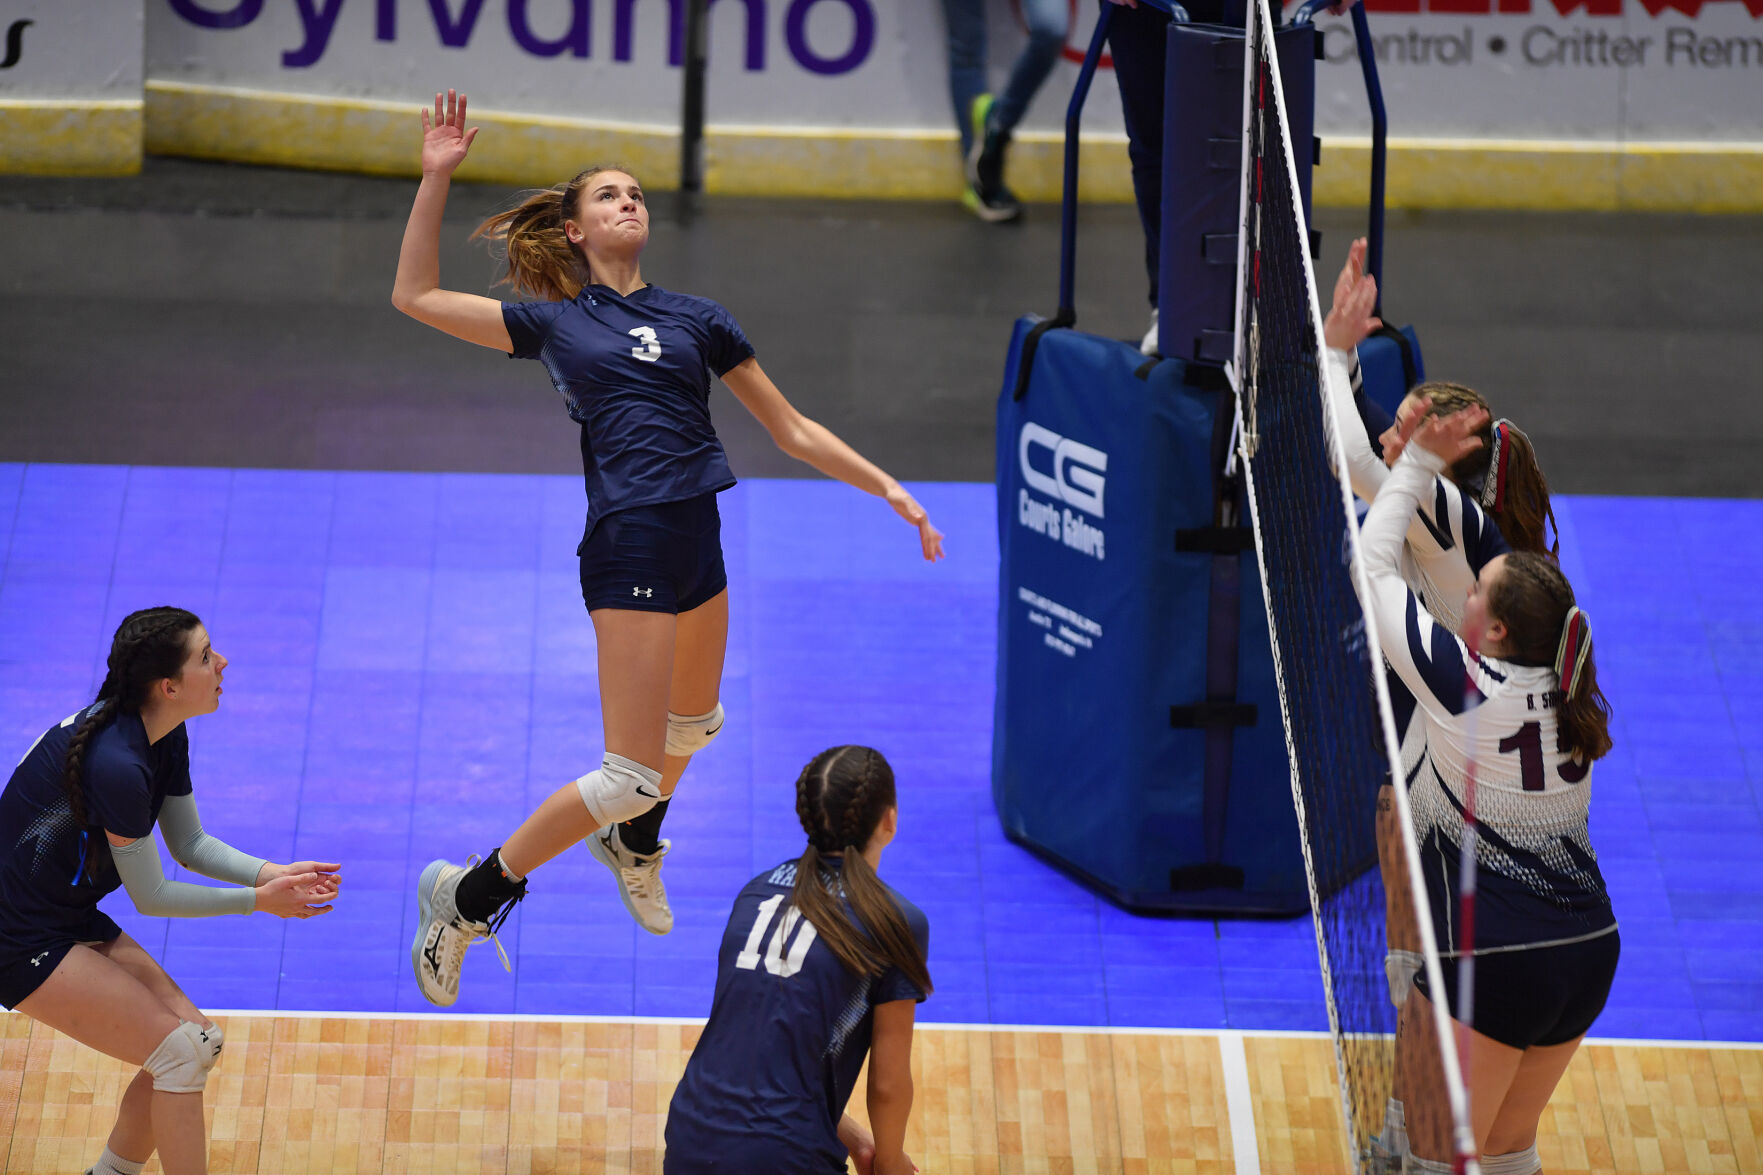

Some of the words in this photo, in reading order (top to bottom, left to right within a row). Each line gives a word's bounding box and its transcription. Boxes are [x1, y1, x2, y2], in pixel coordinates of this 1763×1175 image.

[168, 0, 877, 76] yvamo
[1521, 25, 1653, 67] Critter
[628, 326, 661, 361] 3
[735, 893, 818, 978] 10
